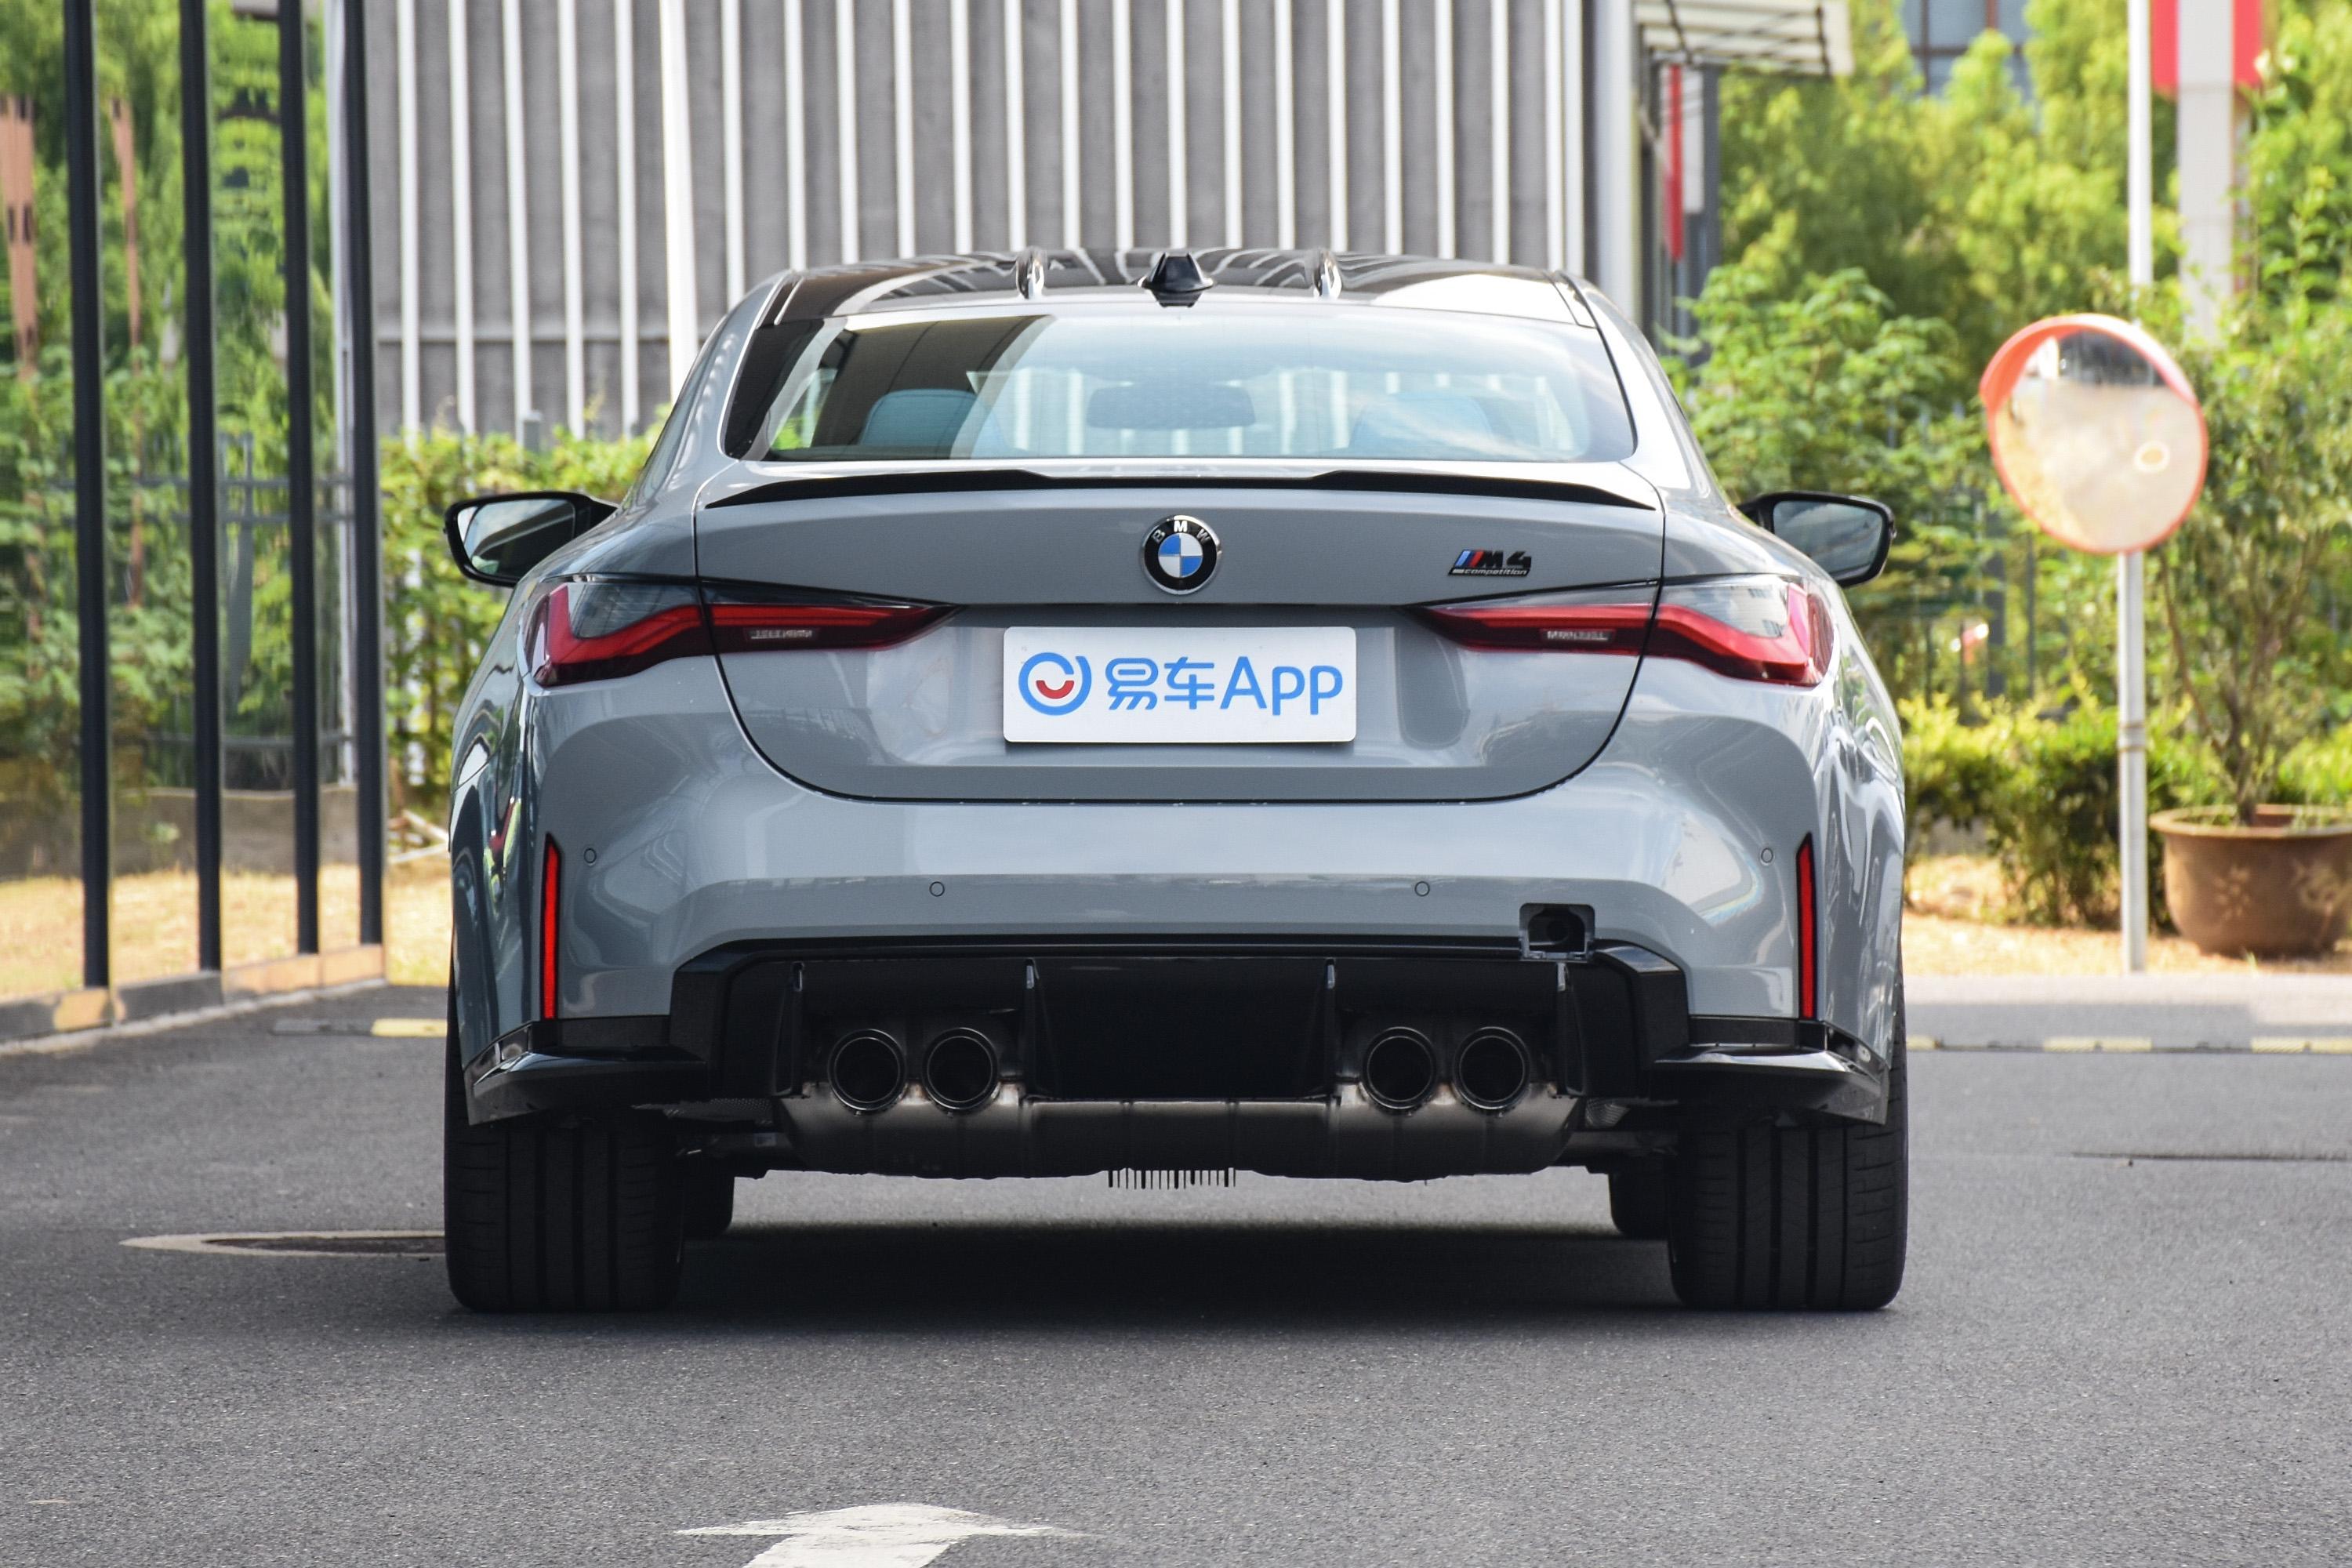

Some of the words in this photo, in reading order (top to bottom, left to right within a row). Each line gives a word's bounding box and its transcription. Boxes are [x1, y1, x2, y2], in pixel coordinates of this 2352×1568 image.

[1152, 520, 1211, 544] BMW
[1476, 550, 1532, 568] M4
[1105, 656, 1343, 716] 易车App
